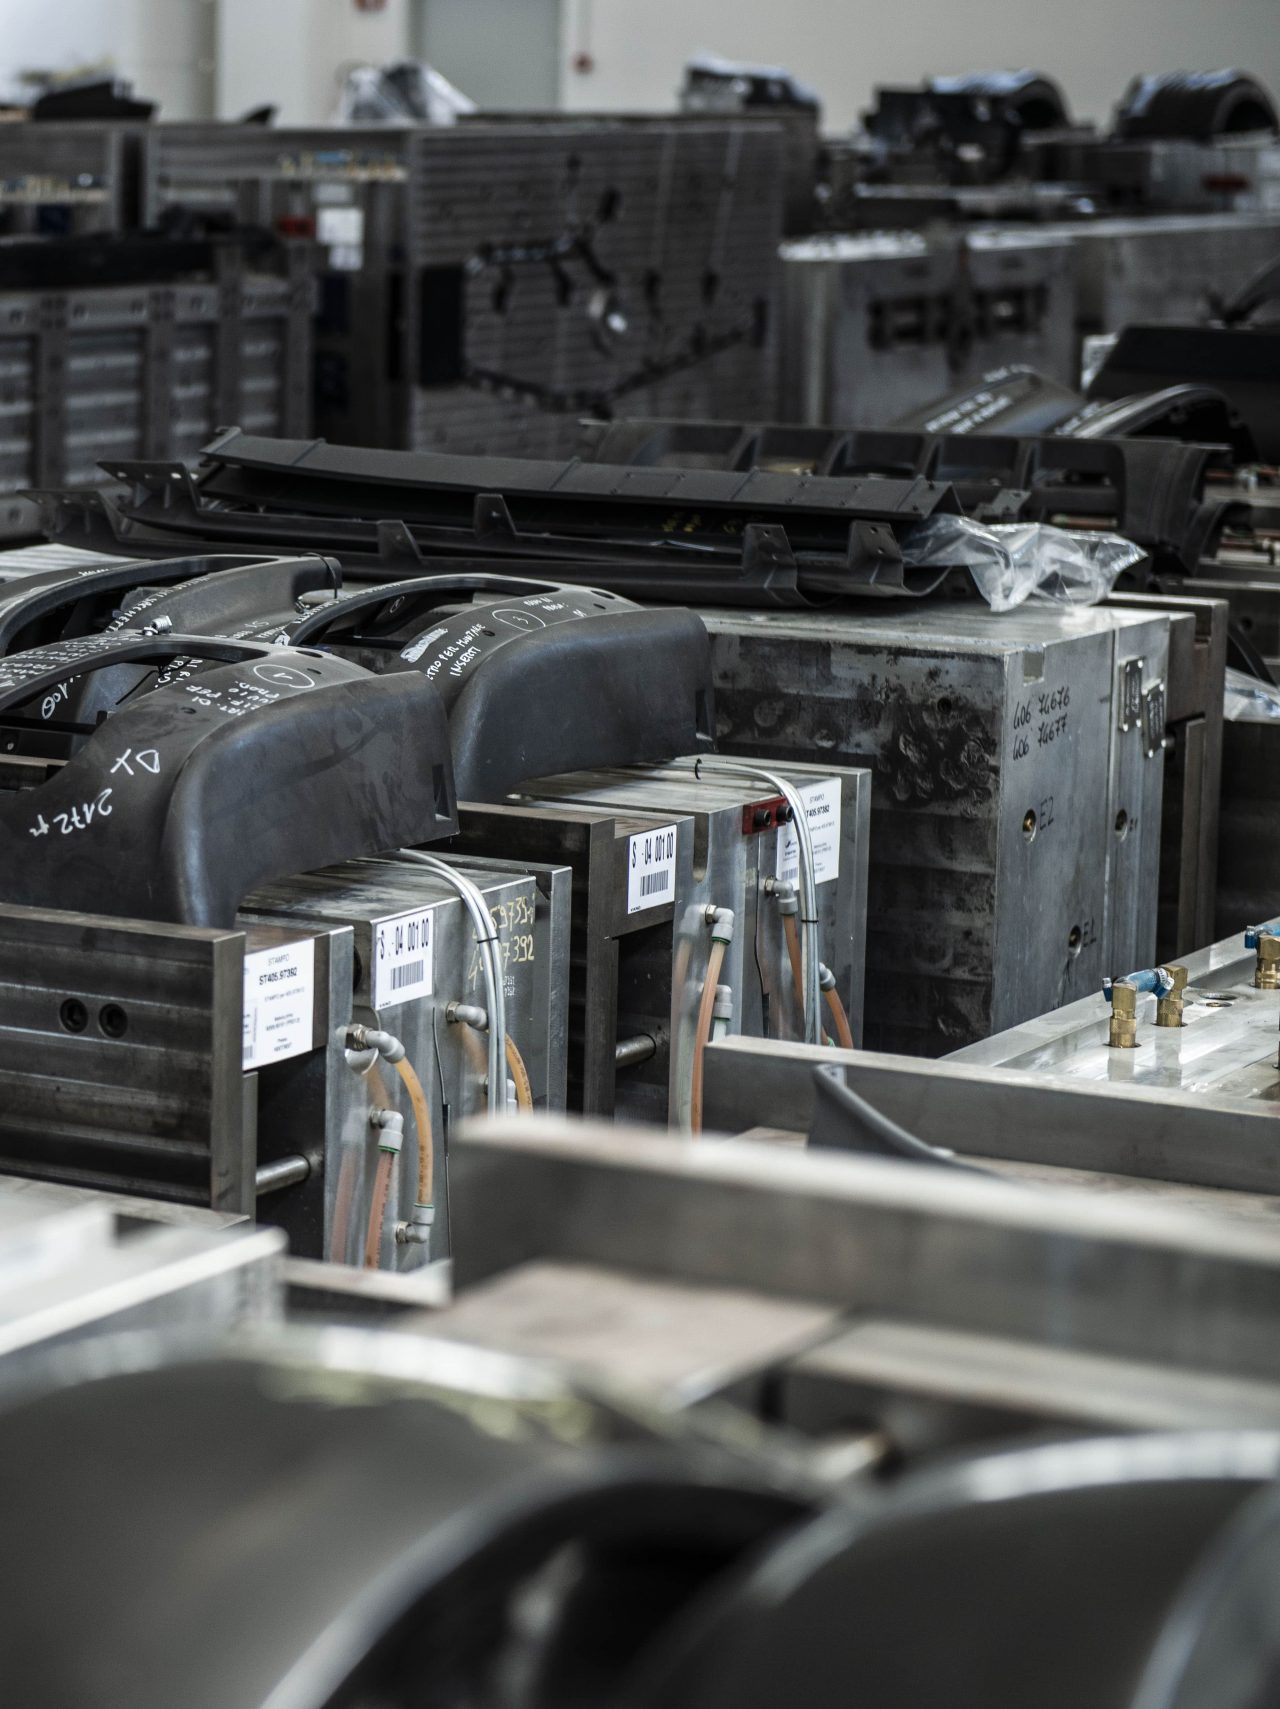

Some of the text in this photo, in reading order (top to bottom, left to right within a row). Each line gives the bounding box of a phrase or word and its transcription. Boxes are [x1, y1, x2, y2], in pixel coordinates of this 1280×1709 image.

[438, 646, 459, 660] PER
[1039, 795, 1054, 831] E2
[631, 840, 637, 869] S
[654, 833, 665, 862] 001
[666, 831, 674, 860] 00
[377, 929, 385, 961] S
[407, 920, 419, 952] 001
[421, 917, 430, 948] 00
